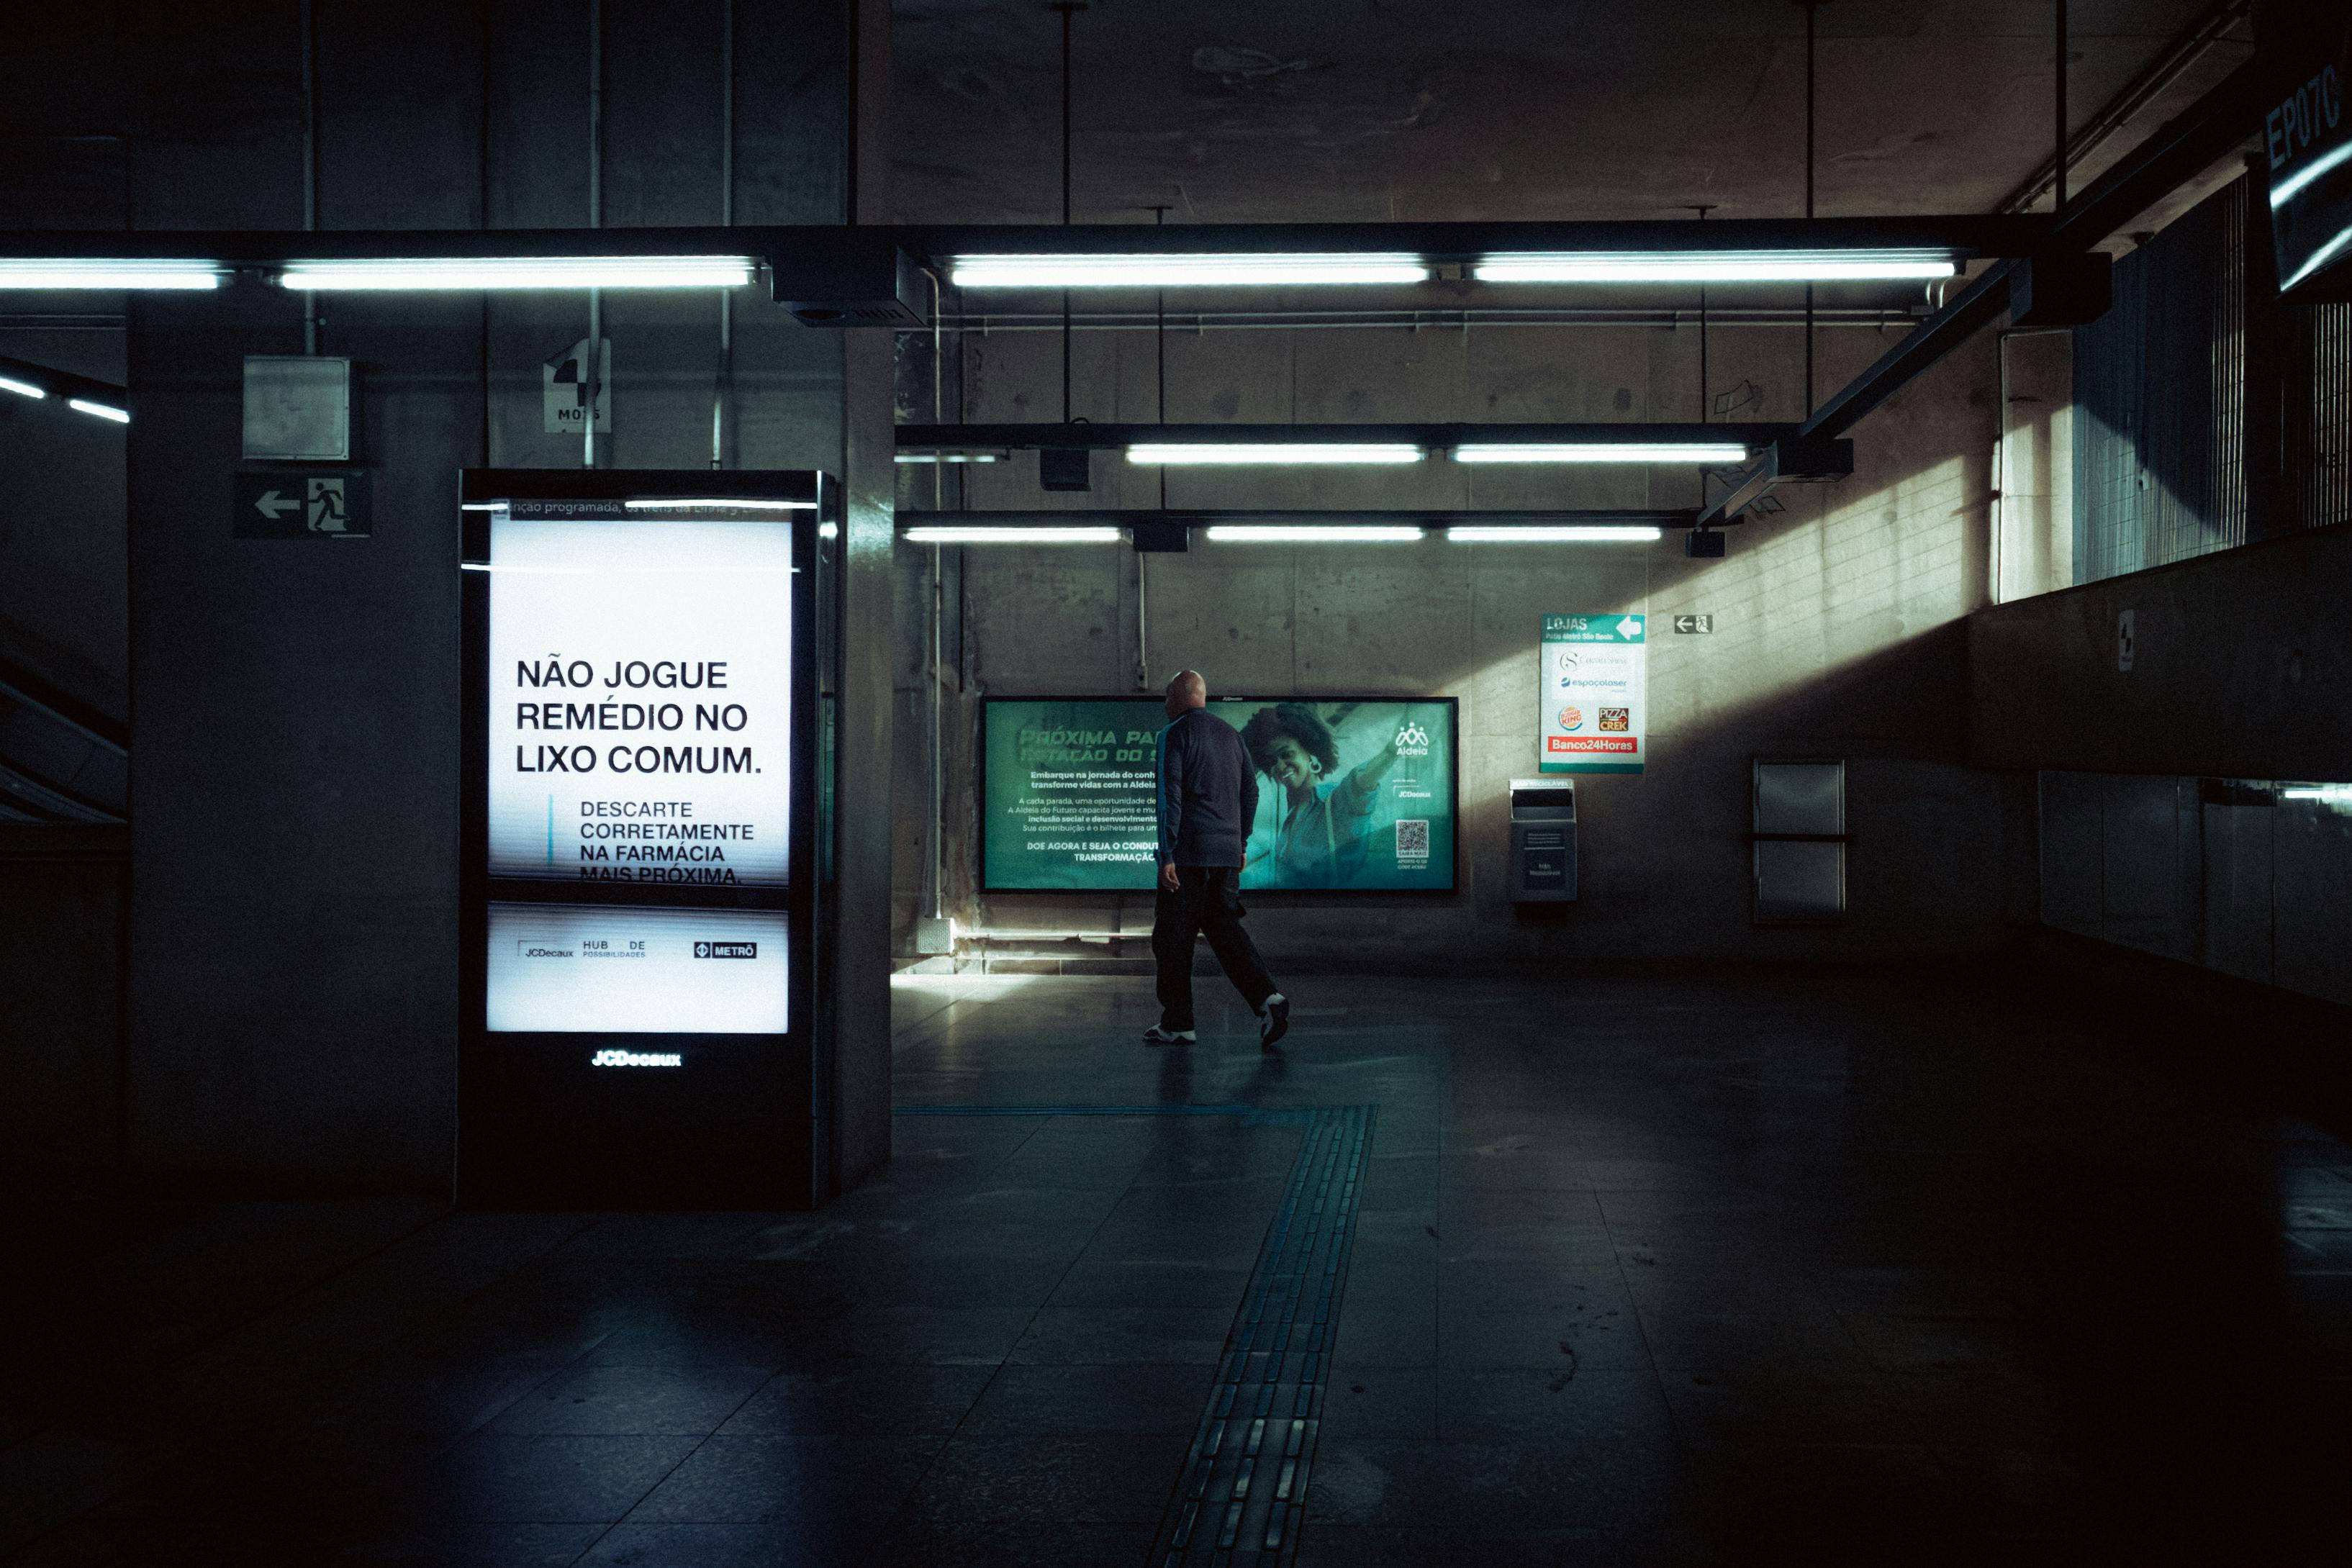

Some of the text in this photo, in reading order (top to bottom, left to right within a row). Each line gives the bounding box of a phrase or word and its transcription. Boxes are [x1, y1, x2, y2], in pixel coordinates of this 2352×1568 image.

[545, 502, 622, 515] programada,
[1547, 617, 1587, 630] LOJAS
[517, 653, 727, 688] NÃO JOGUE
[517, 695, 748, 730] REMÉDIO NO
[1600, 709, 1627, 718] PIZZA
[1562, 715, 1581, 725] KING
[1600, 722, 1627, 730] CREK
[1126, 730, 1159, 744] PA
[1552, 740, 1632, 750] Banco24Horas
[516, 745, 761, 774] LIXO COMUM.
[1031, 771, 1074, 780] Embarque
[1088, 771, 1120, 780] jornada
[581, 801, 692, 817] DESCARTE
[580, 823, 754, 840] CORRETAMENTE
[581, 840, 725, 861] NA FARMÁCIA
[580, 867, 632, 882] MAIS
[715, 945, 754, 956] METRÔ
[592, 1051, 682, 1066] JCDecaux
